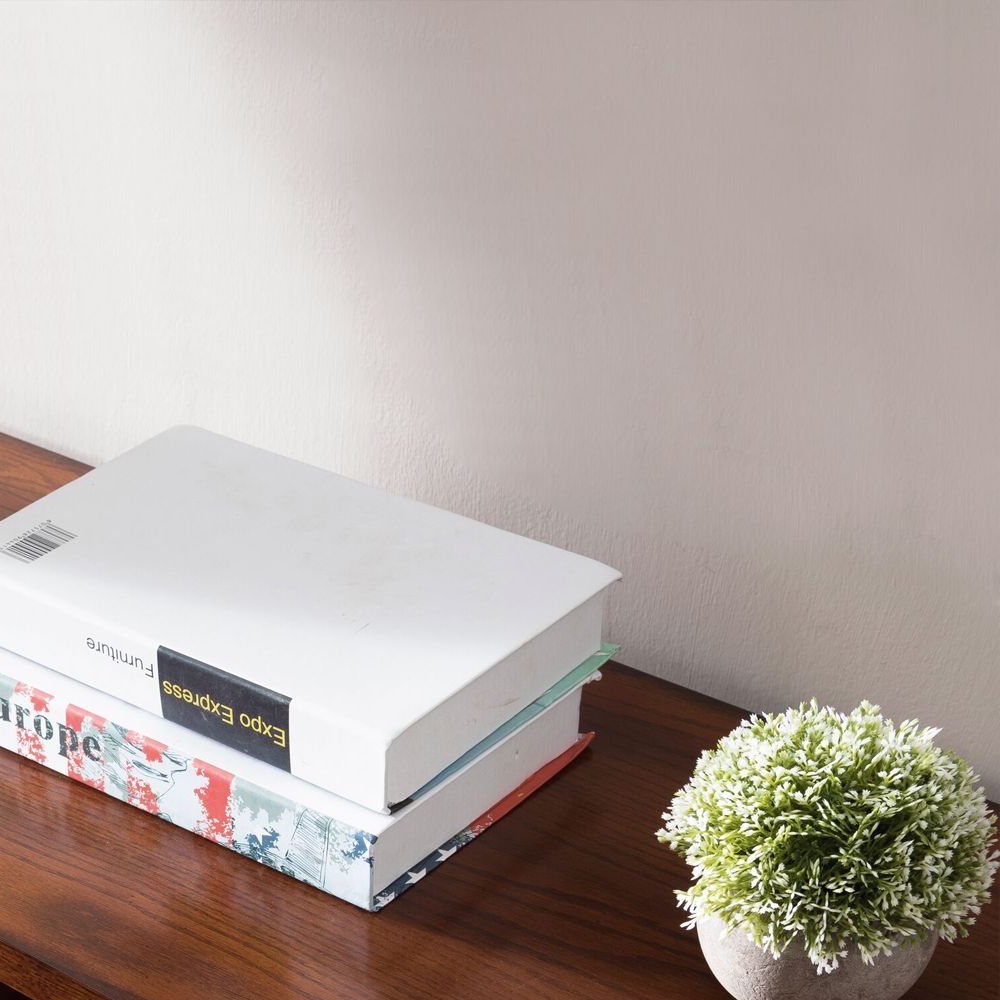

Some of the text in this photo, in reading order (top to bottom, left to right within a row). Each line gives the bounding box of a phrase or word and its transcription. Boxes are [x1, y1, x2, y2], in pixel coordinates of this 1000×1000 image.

[86, 637, 155, 679] Furniture
[161, 679, 287, 748] Expo Express
